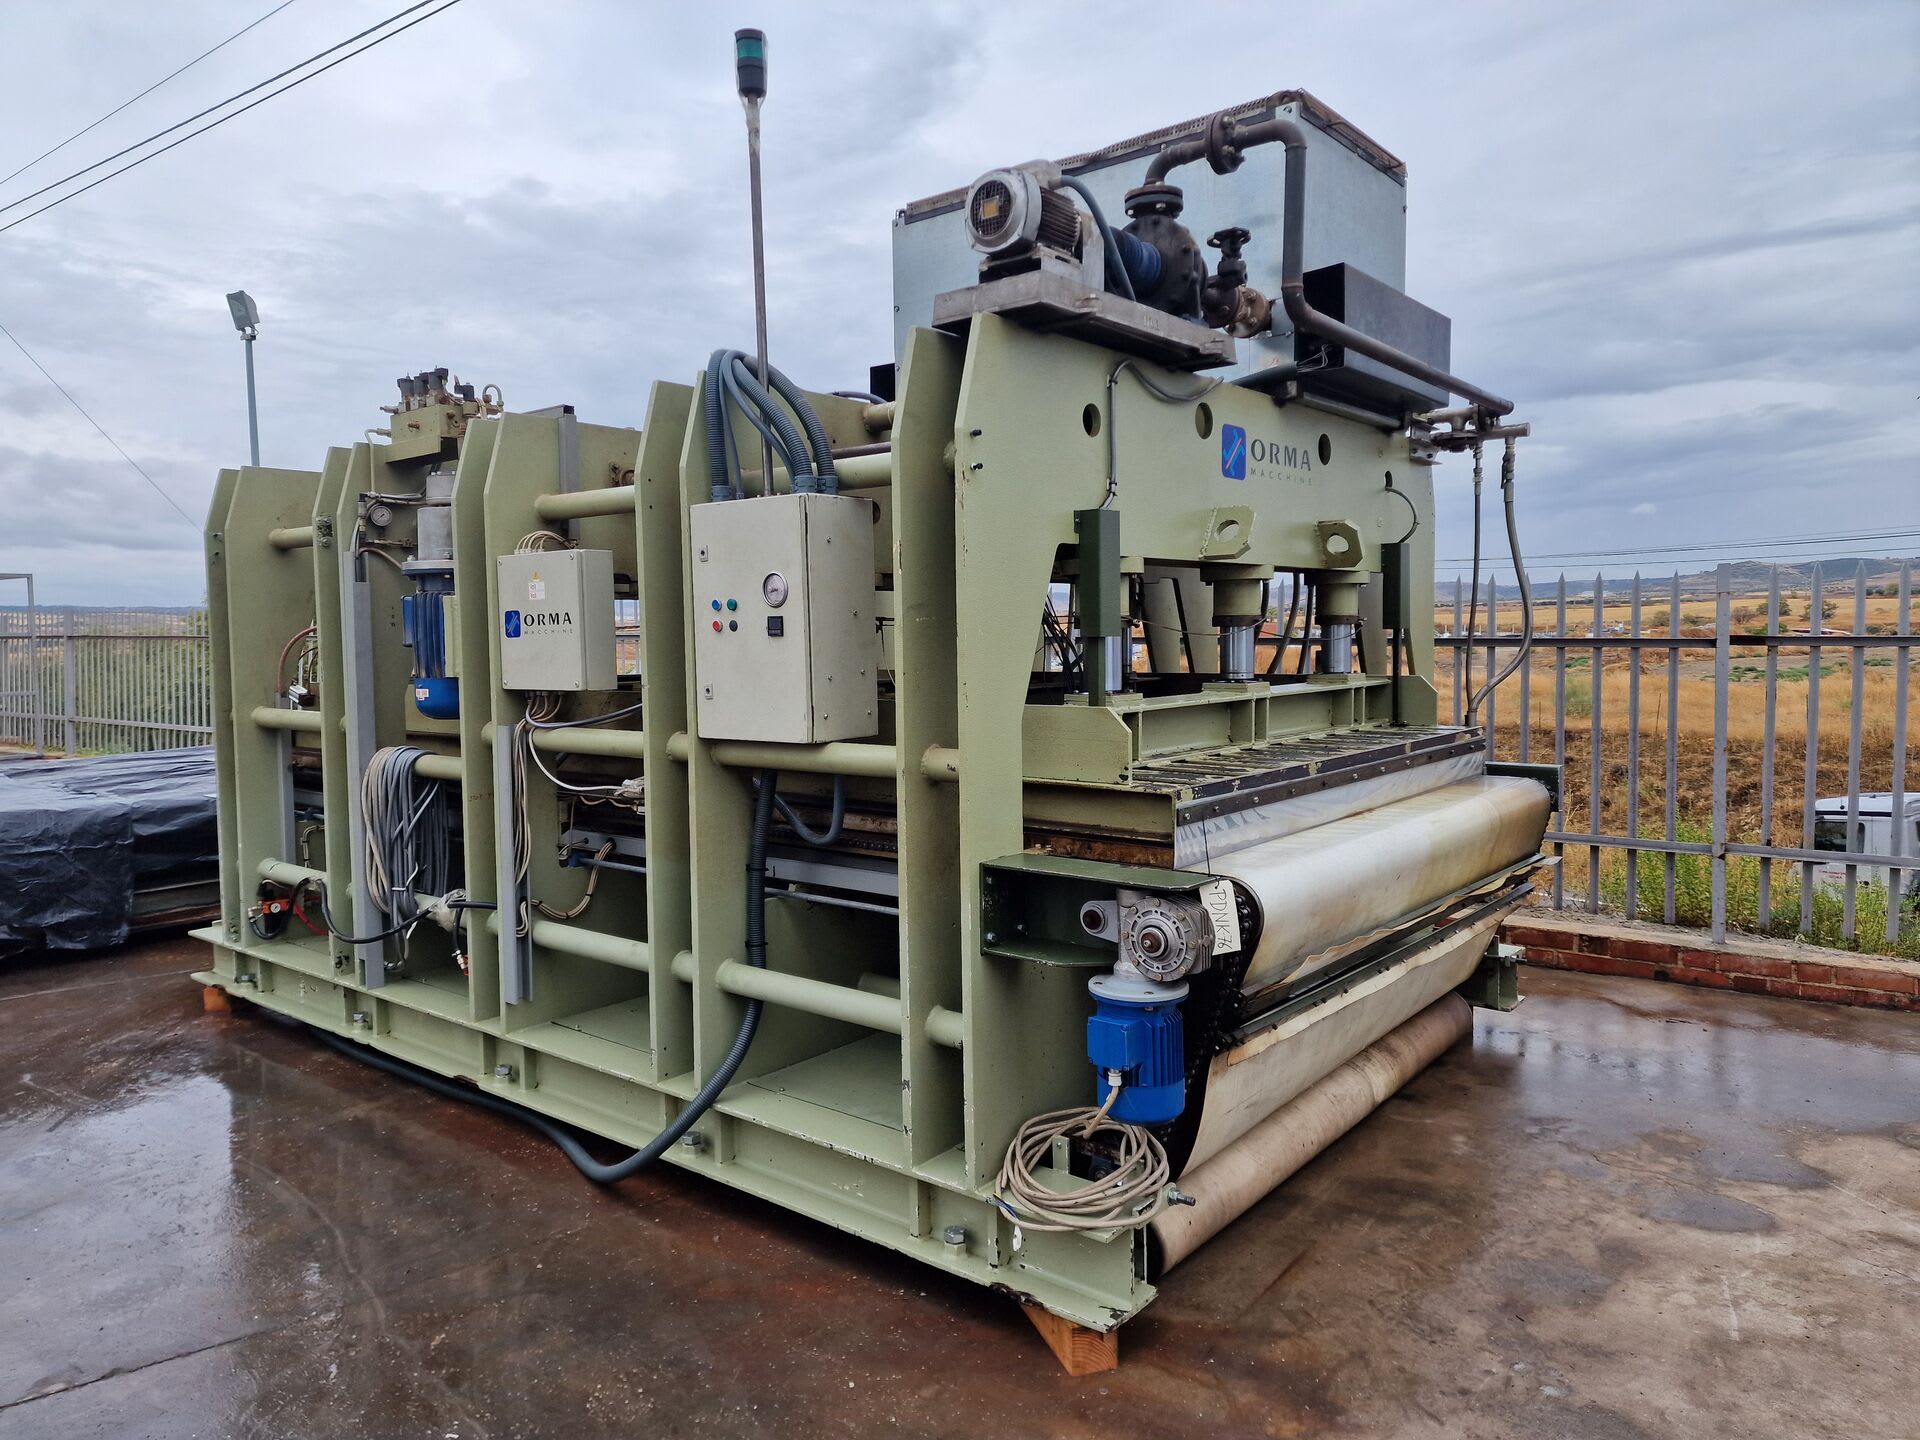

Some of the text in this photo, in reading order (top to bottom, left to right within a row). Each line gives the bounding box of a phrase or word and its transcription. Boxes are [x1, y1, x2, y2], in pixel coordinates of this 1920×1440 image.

[1250, 438, 1312, 472] ORMA
[1250, 467, 1312, 486] MACCHINE
[523, 611, 572, 627] ORMA
